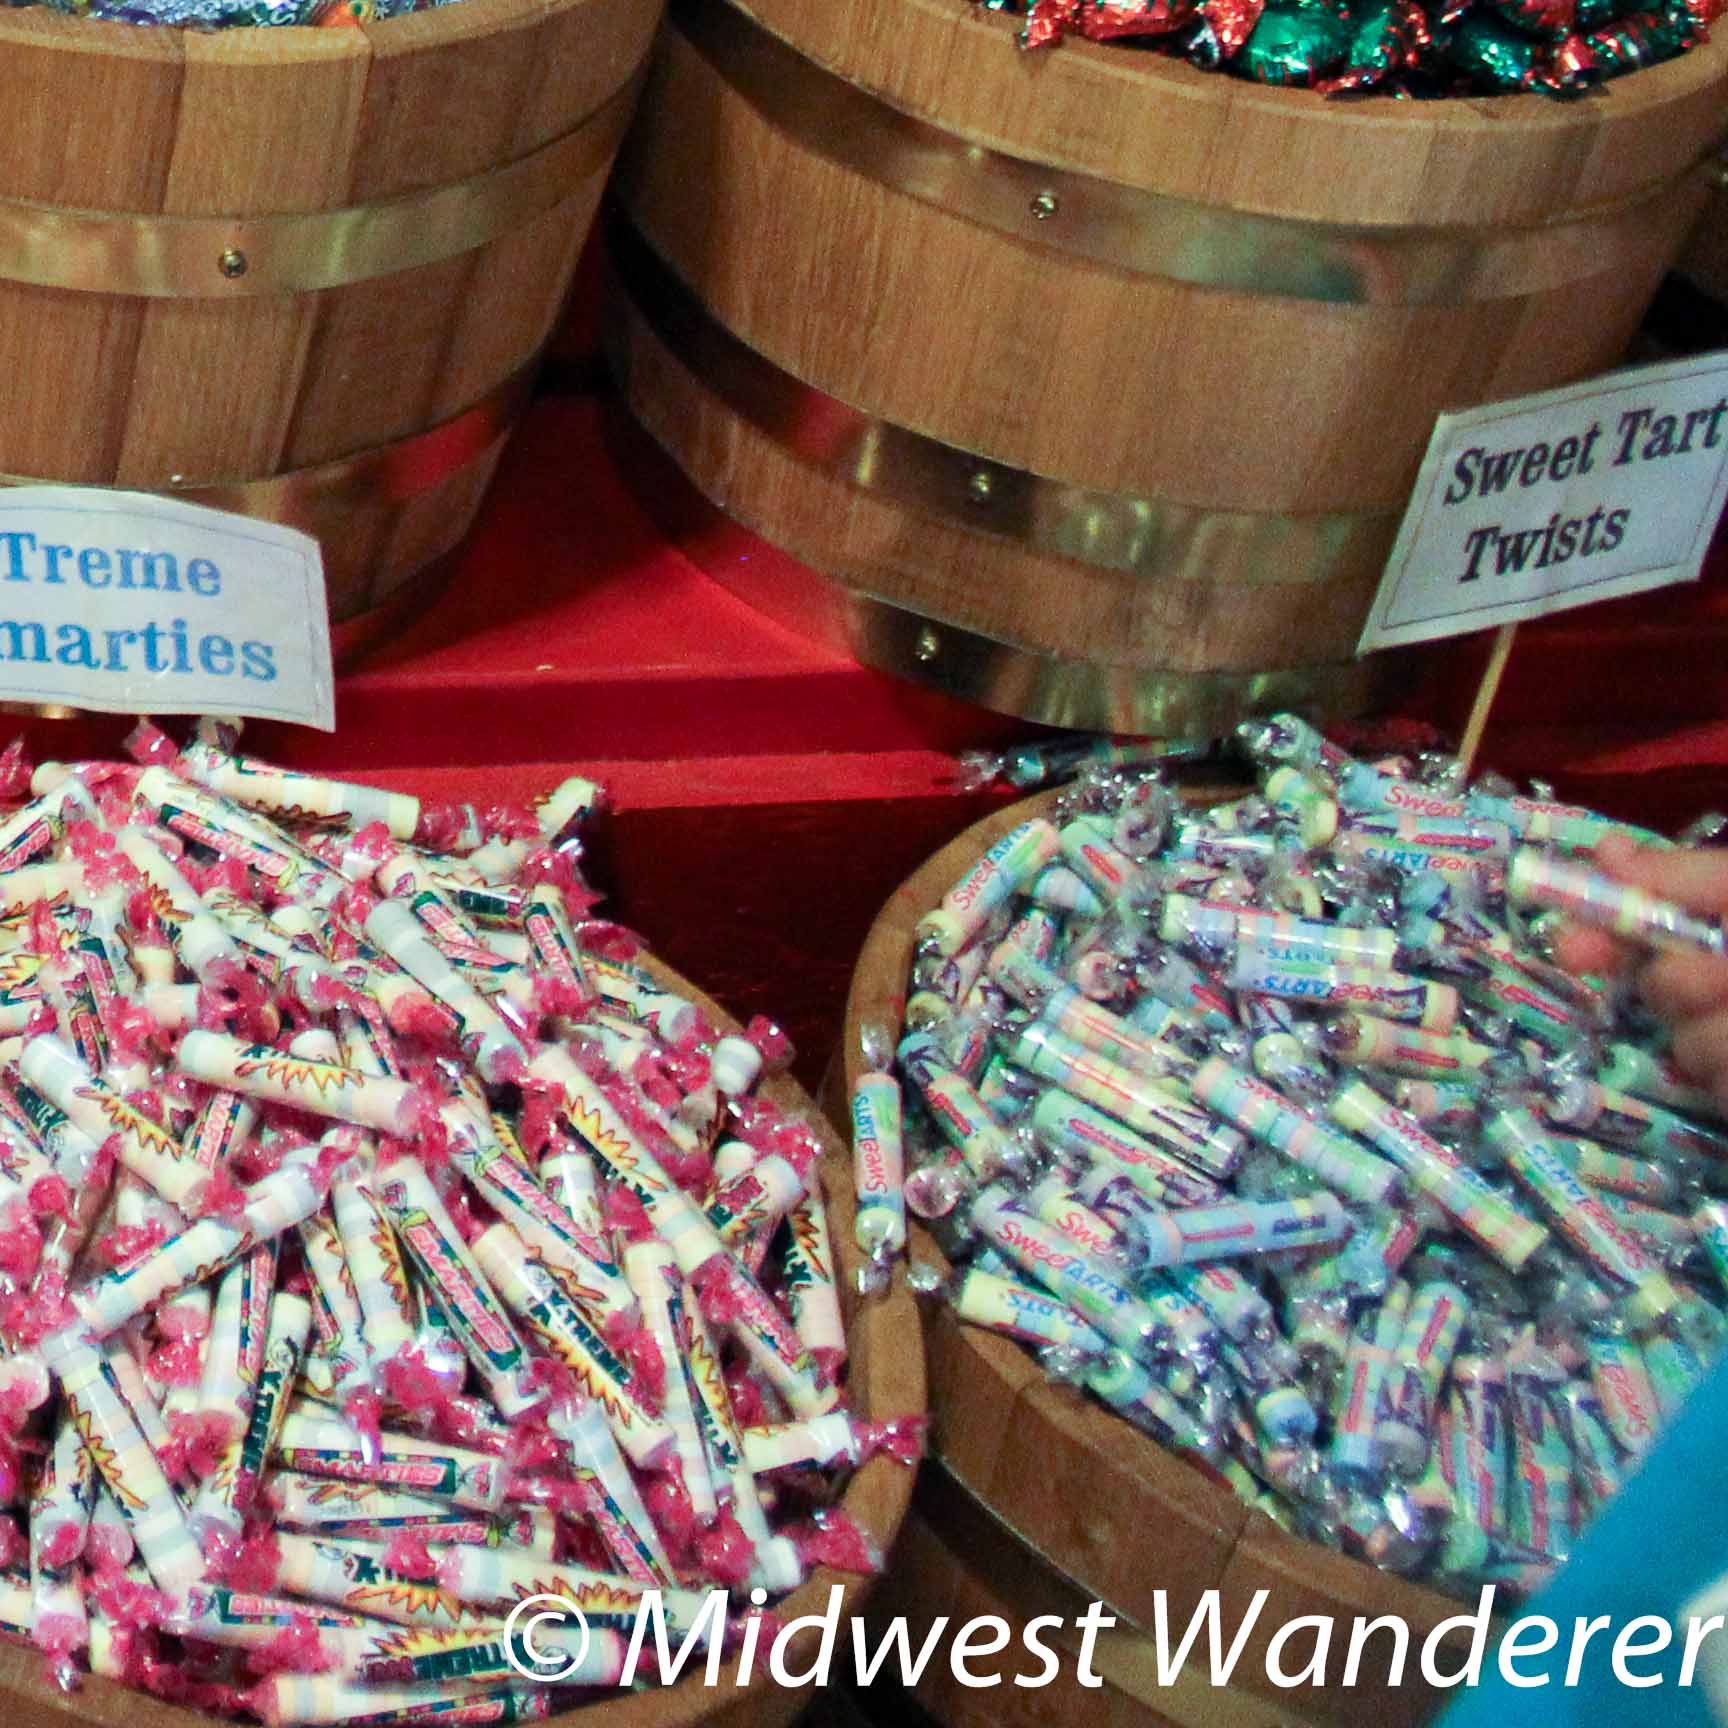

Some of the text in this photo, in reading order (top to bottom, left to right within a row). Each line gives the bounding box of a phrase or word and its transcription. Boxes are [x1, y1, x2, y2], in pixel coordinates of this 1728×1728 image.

[1443, 397, 1728, 506] Sweet Tart
[1458, 506, 1631, 584] Twists
